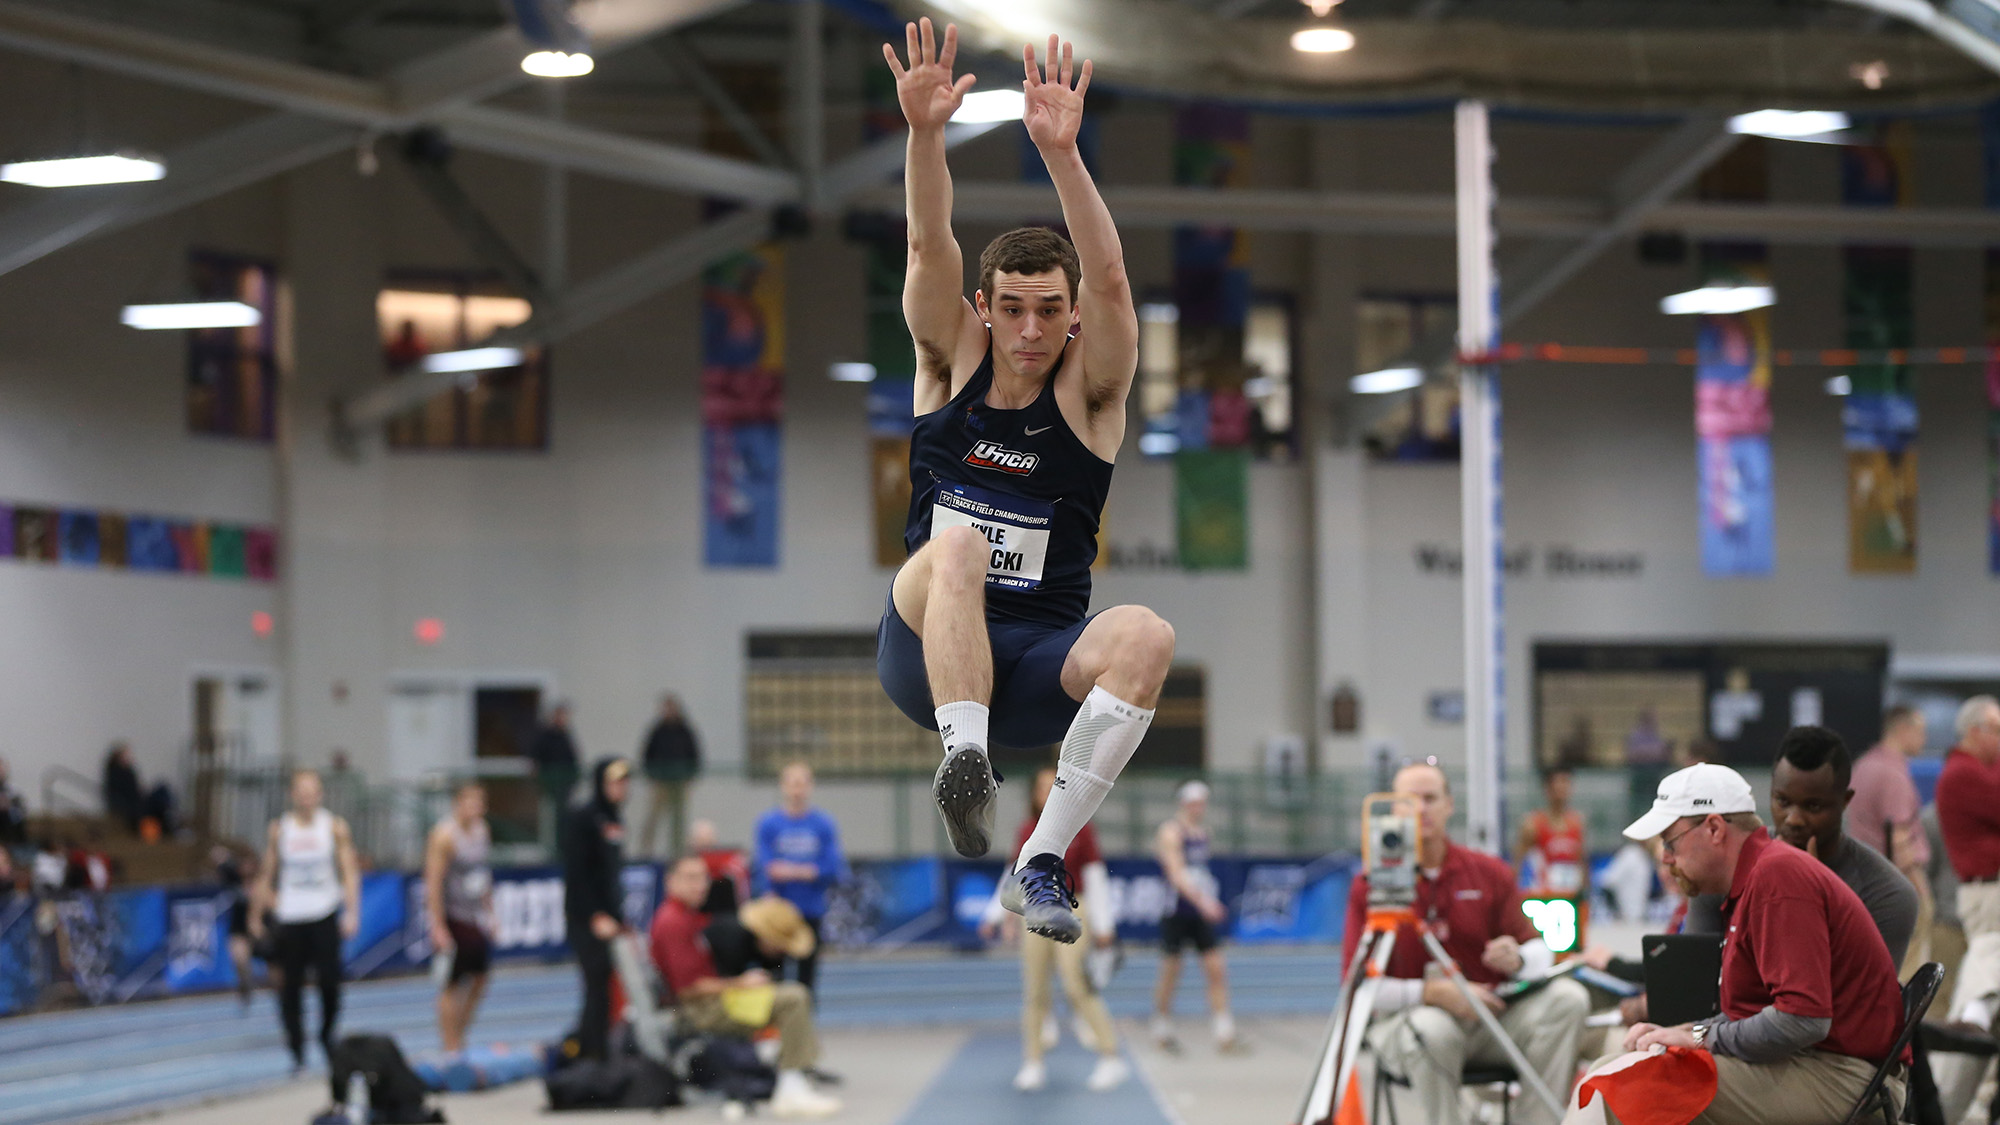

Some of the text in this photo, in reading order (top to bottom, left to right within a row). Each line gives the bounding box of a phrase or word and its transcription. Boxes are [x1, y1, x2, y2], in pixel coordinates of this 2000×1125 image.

[974, 443, 1035, 469] UTICA
[952, 497, 972, 511] TRACK
[976, 505, 994, 516] FIELD
[994, 509, 1049, 525] CHAMPIONSHIPS
[998, 577, 1018, 586] MARCH
[1693, 798, 1713, 806] GILL
